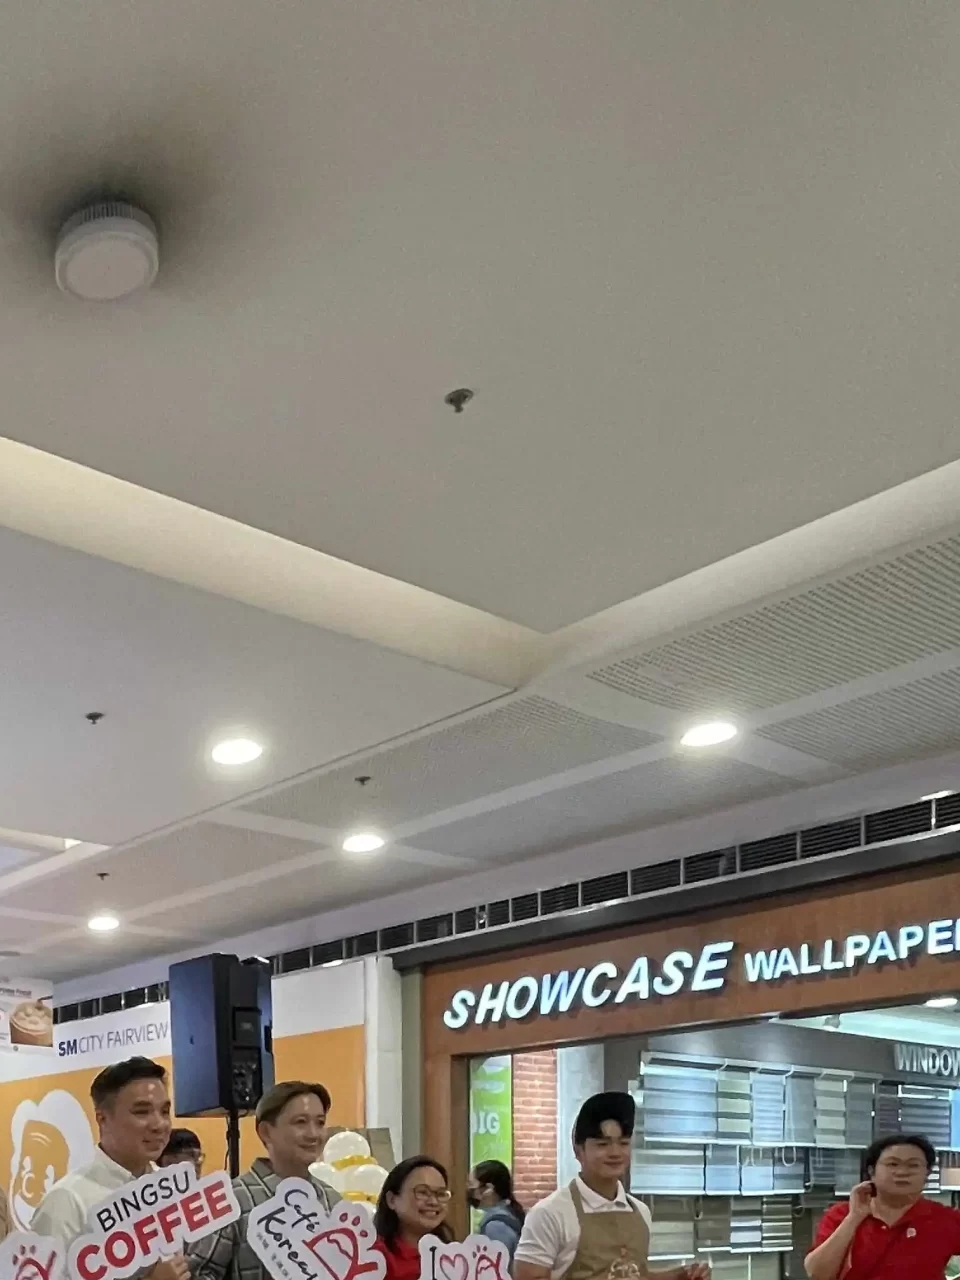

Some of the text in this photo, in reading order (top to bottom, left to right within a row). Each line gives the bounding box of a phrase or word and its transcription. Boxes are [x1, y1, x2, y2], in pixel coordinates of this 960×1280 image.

[443, 918, 960, 1028] SHOWCASE WALLPAPE
[58, 1020, 168, 1056] SM CITY FAIRVIEW
[96, 1170, 190, 1232] BINGSU
[284, 1189, 320, 1233] Café
